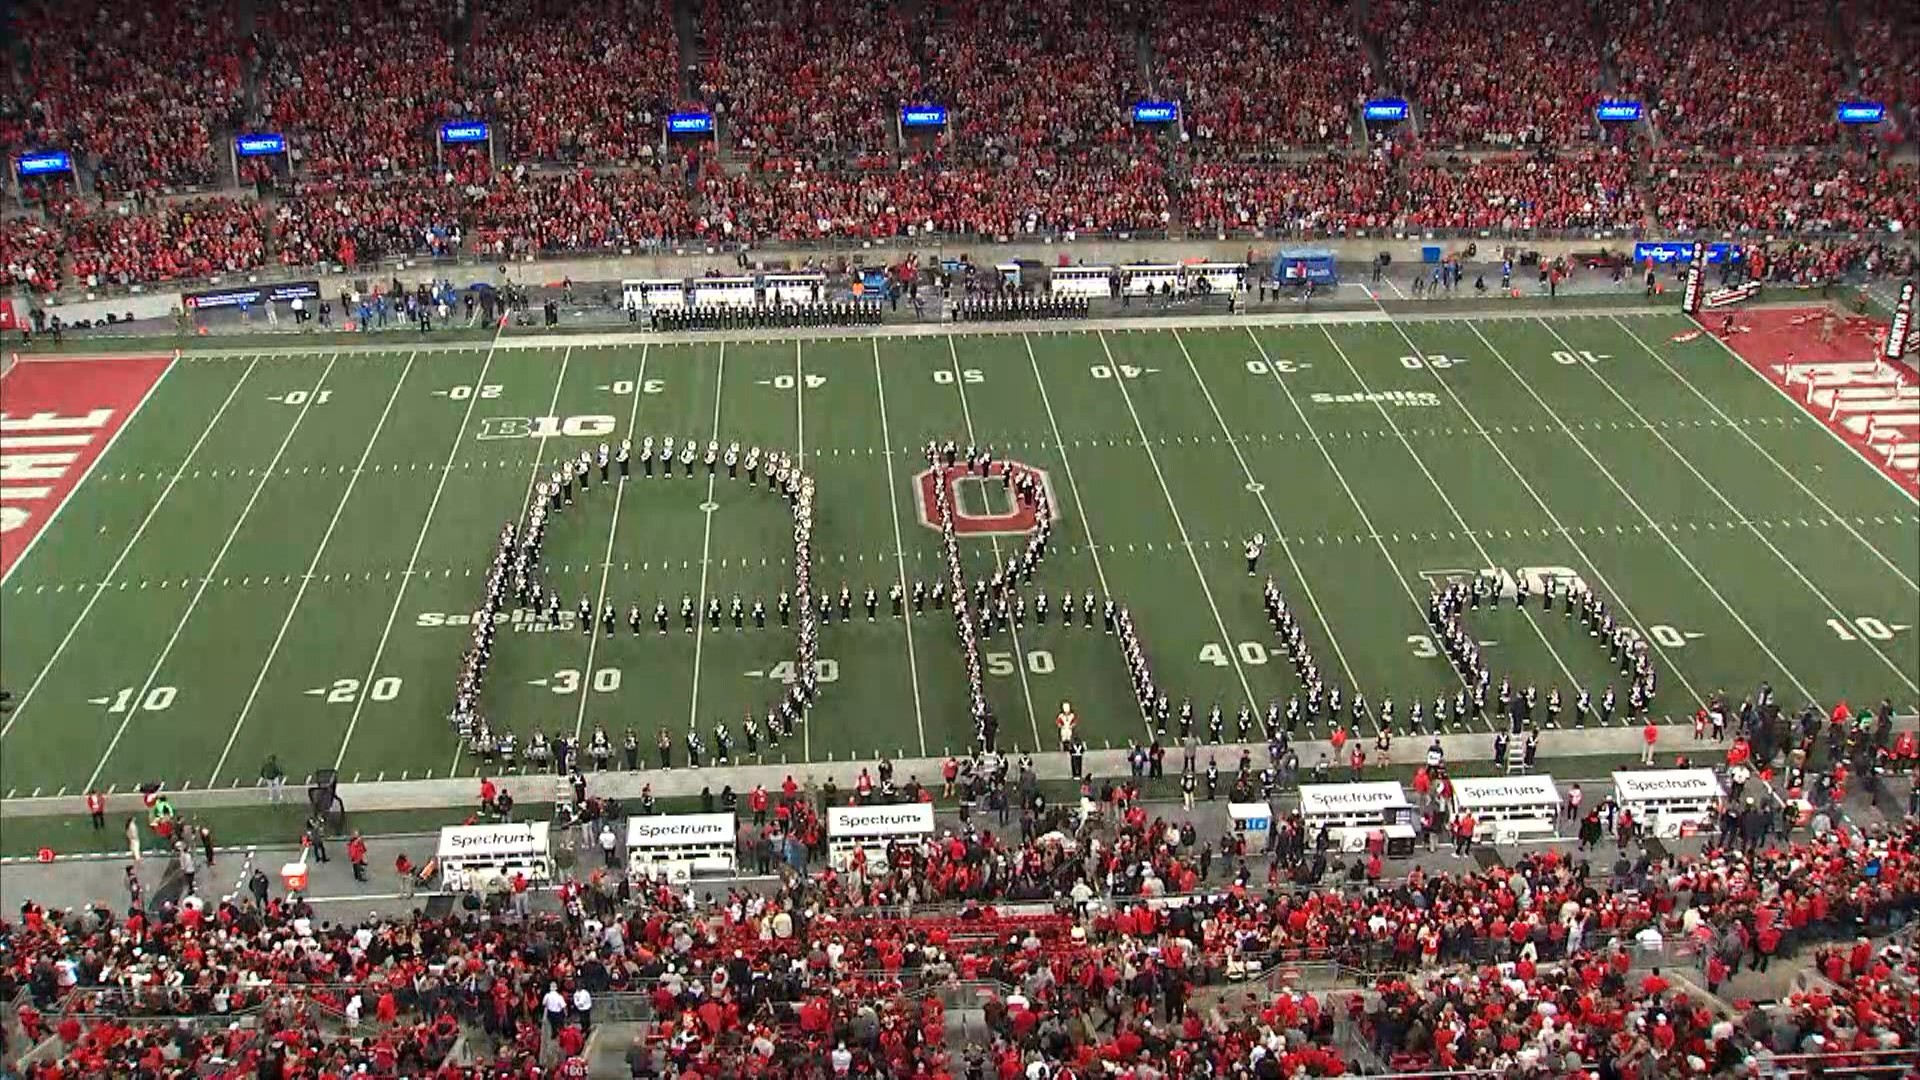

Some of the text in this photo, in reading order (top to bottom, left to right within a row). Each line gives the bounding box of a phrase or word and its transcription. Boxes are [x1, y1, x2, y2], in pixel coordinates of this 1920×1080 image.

[1827, 617, 1895, 640] 10
[986, 650, 1055, 675] 50
[1199, 642, 1268, 666] 40
[551, 668, 621, 694] 30
[768, 659, 839, 684] 40
[108, 687, 177, 712] 10
[327, 677, 403, 703] 20
[1464, 785, 1543, 801] Spectrum
[1627, 777, 1707, 793] Spectrum
[1312, 791, 1391, 808] Spectrum
[639, 823, 721, 839] Spectrum
[839, 813, 921, 829] Spectrum
[451, 832, 533, 849] Spectrum
